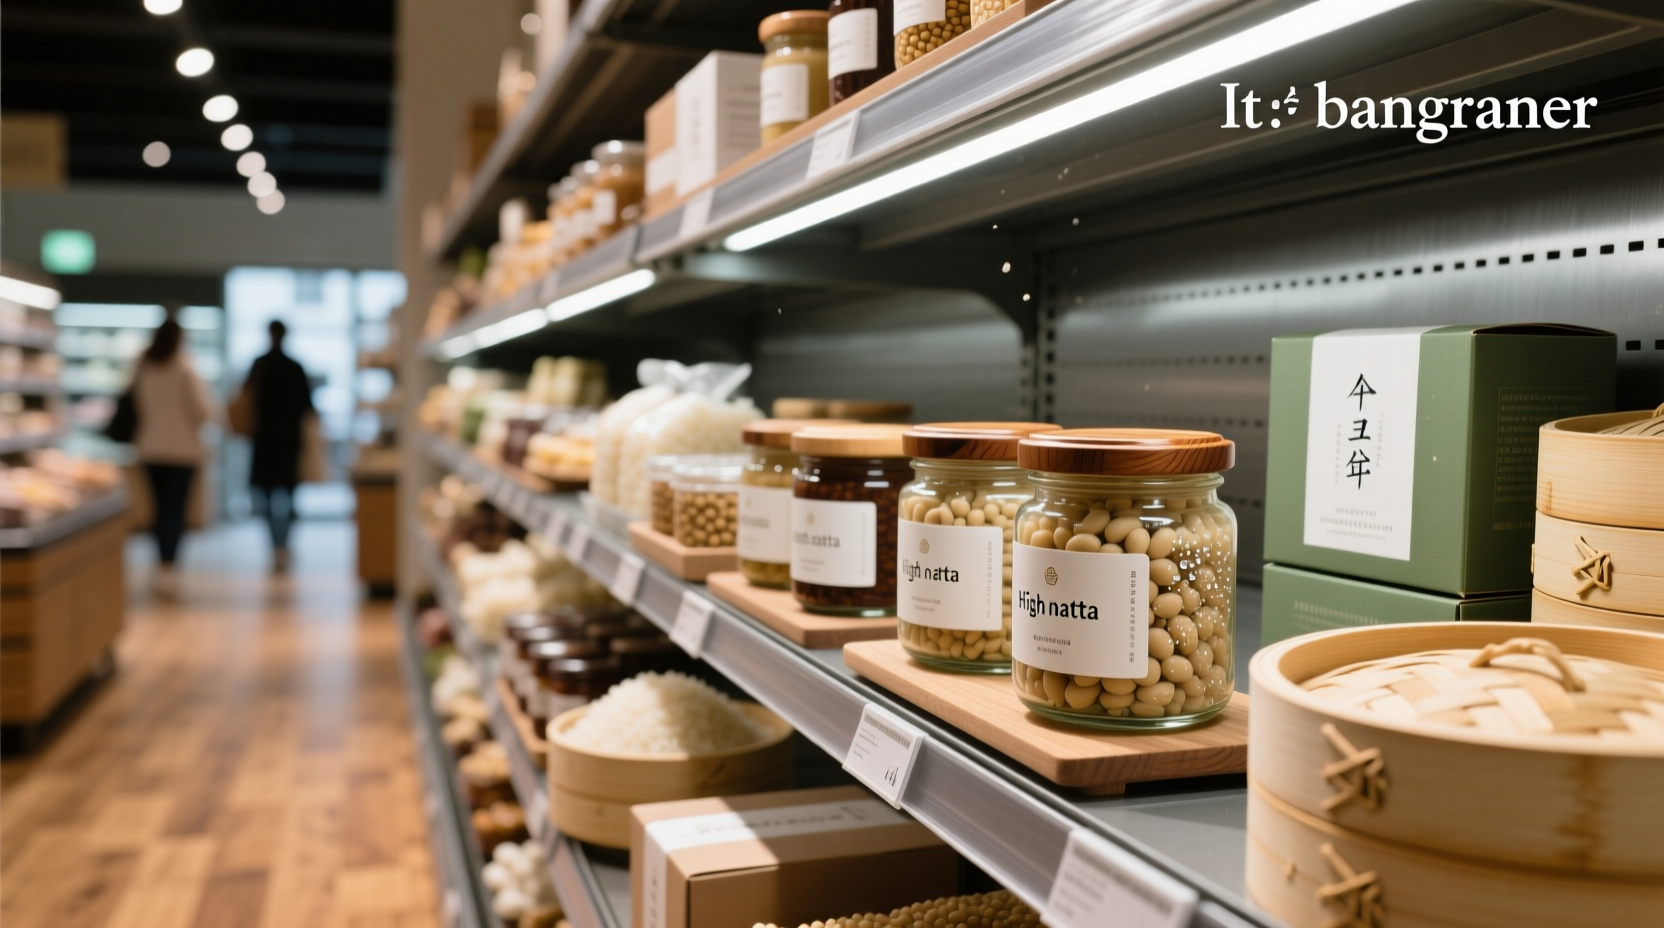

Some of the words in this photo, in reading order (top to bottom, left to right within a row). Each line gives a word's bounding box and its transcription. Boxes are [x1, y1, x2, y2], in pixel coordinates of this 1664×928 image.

[924, 565, 959, 583] natta
[1018, 589, 1046, 618] High
[1048, 600, 1099, 621] natta
